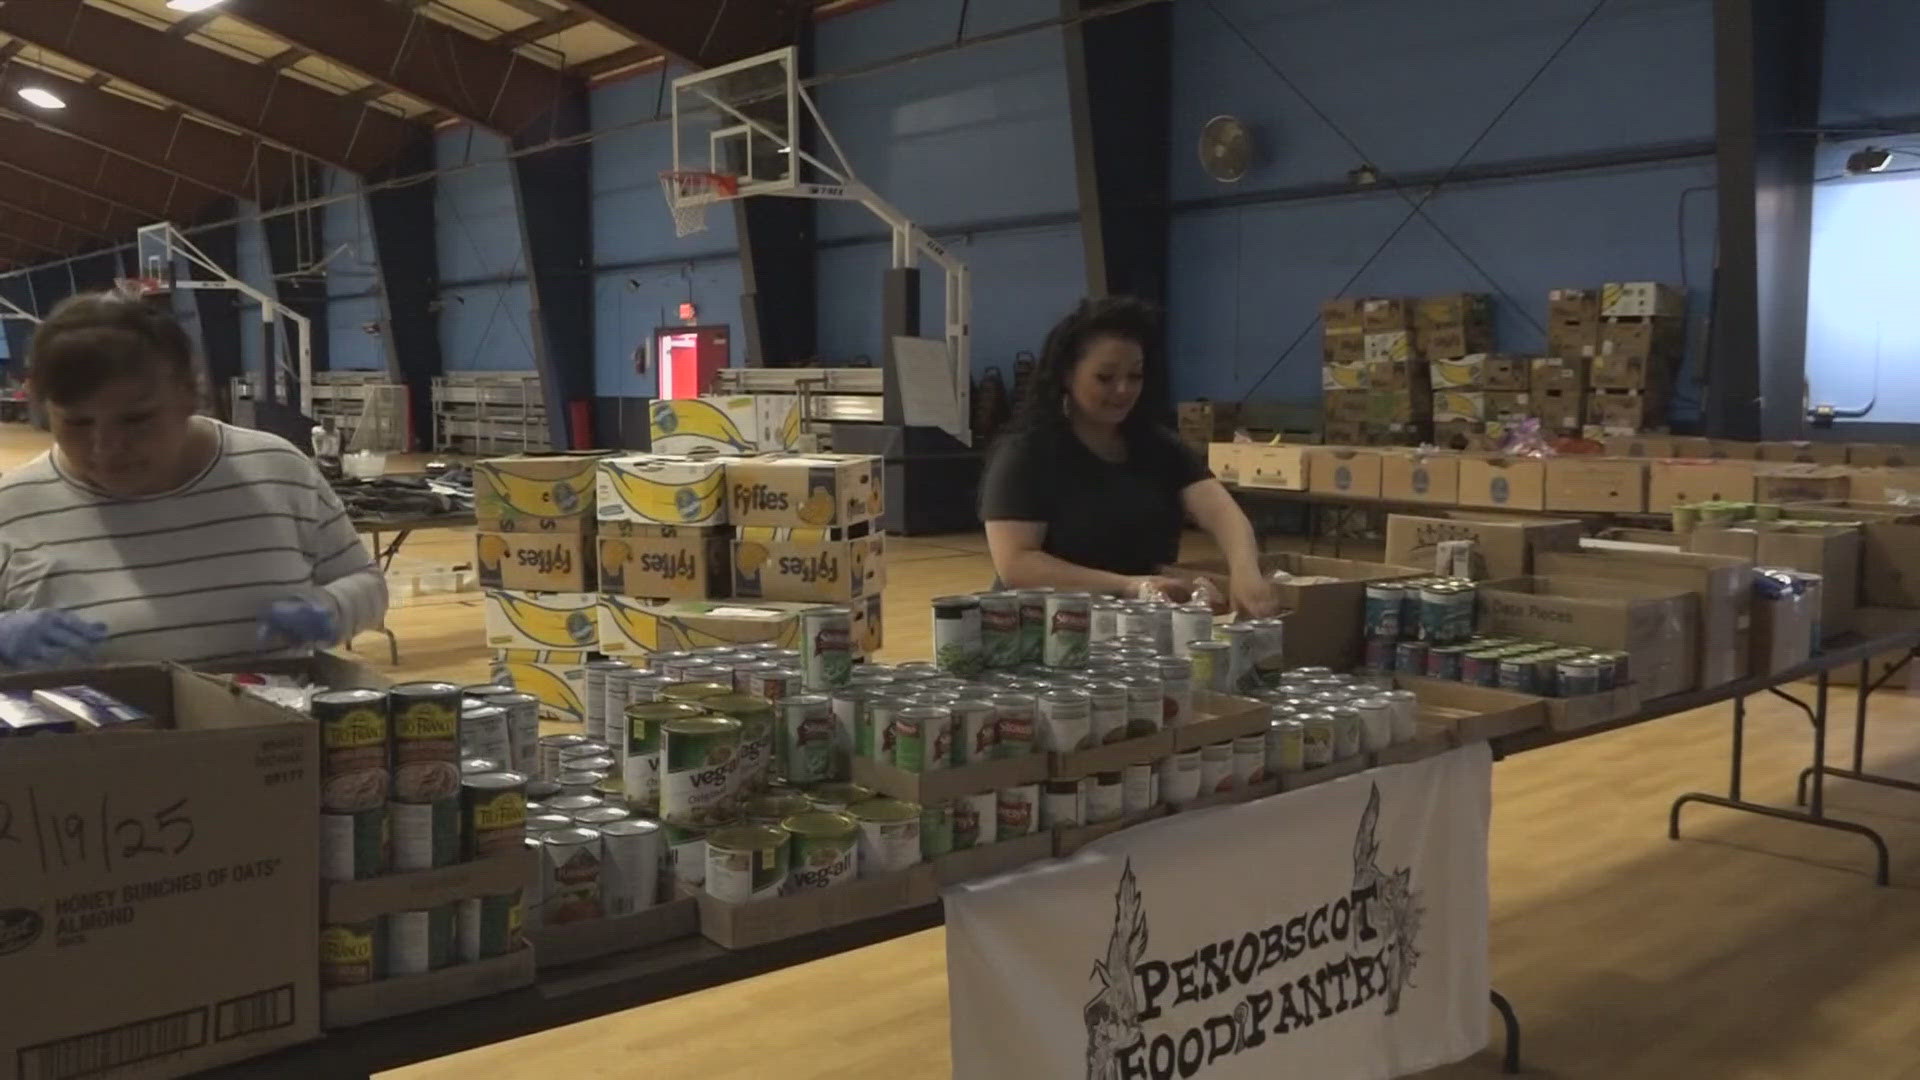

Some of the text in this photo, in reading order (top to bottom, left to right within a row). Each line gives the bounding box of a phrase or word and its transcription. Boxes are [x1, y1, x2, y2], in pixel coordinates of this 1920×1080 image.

[55, 906, 136, 936] ALMOND
[56, 889, 117, 916] HONEY
[122, 872, 203, 904] BUNCHES
[207, 866, 229, 888] OF
[1134, 882, 1378, 1022] PENOBSCOT
[1117, 943, 1394, 1080] FOOD PANTRY
